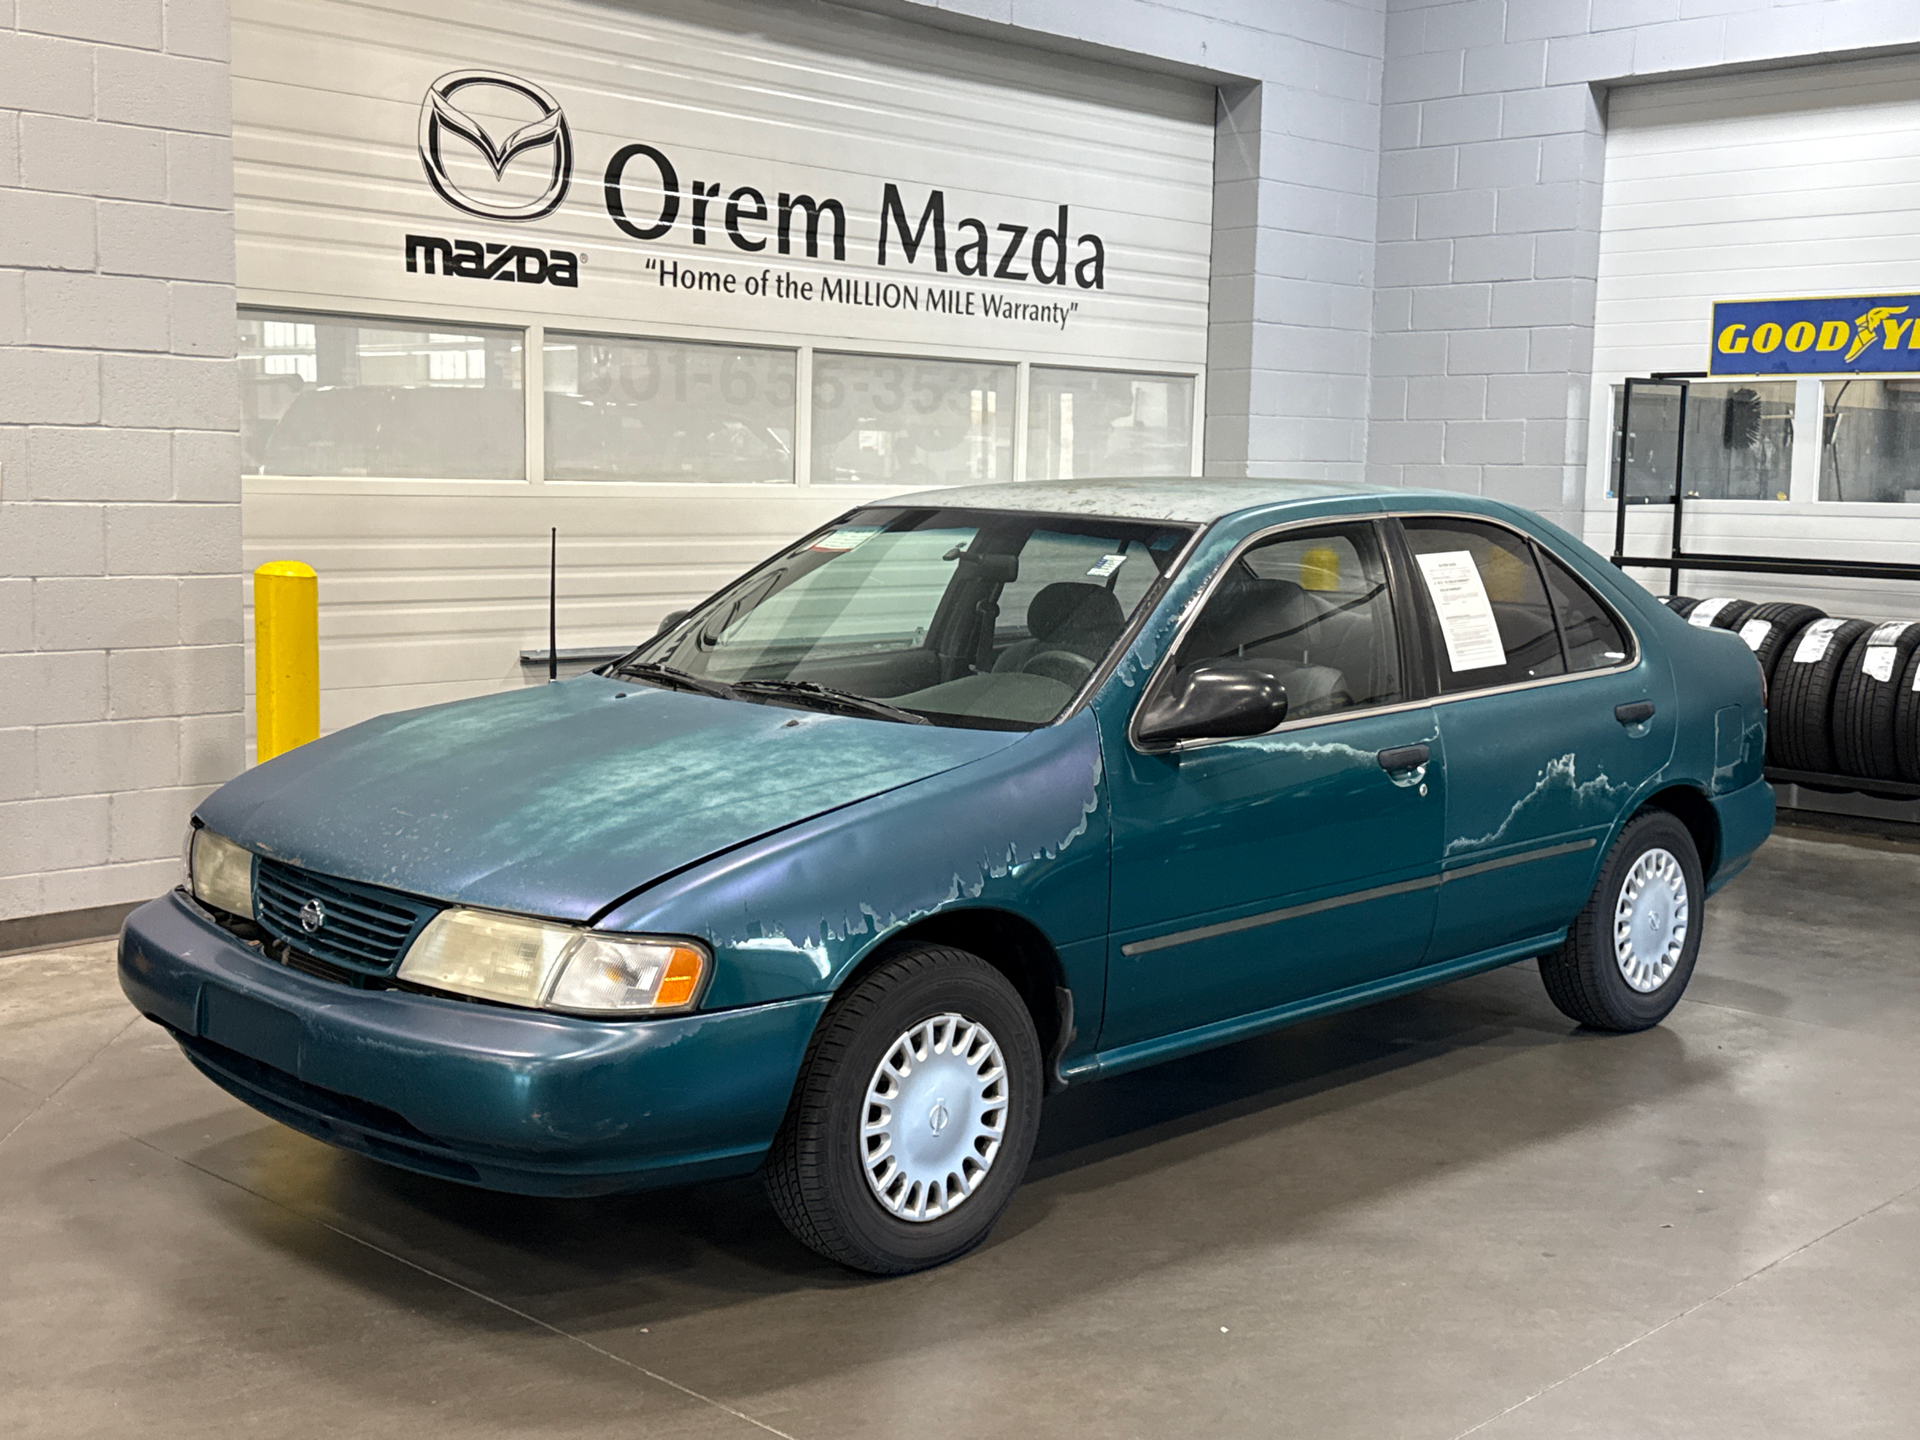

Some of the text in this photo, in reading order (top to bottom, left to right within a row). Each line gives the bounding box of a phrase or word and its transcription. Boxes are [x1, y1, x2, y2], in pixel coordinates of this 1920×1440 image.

[604, 143, 1105, 290] Orem Mazda
[645, 257, 1079, 331] “Home of the MILLION MILE Warranty”
